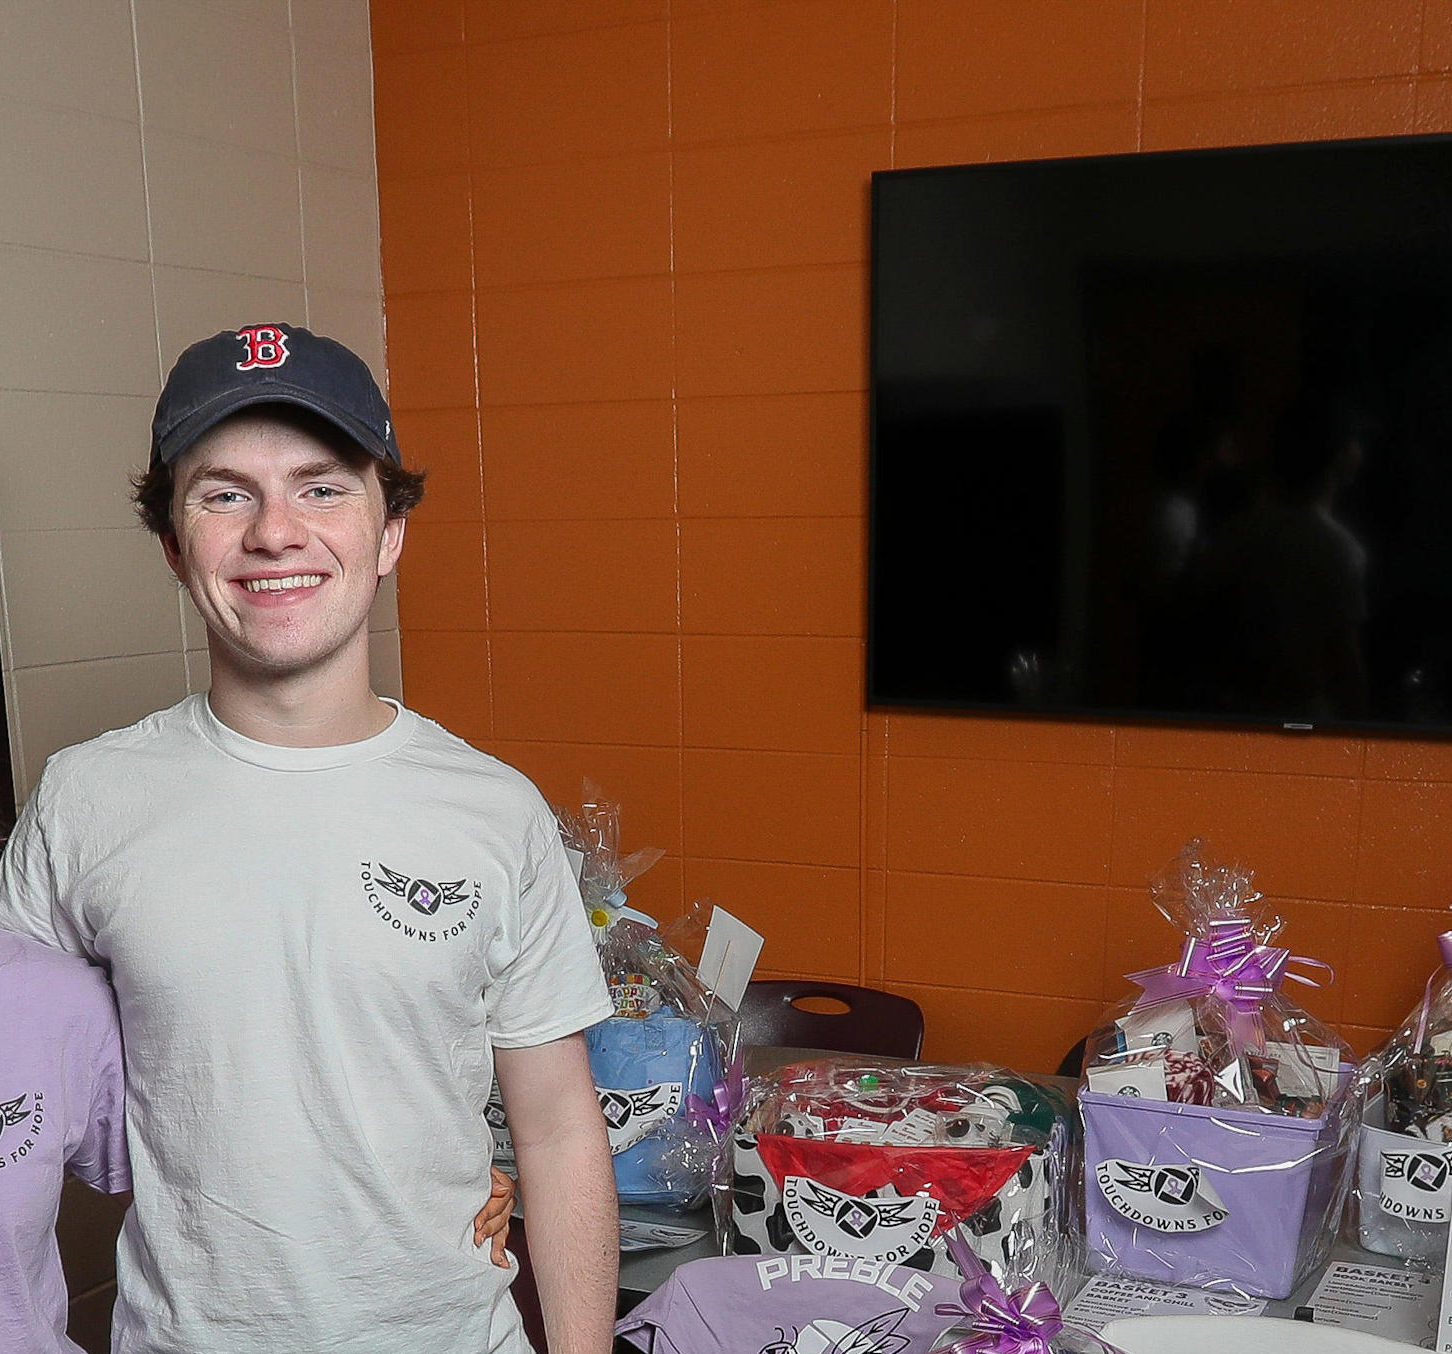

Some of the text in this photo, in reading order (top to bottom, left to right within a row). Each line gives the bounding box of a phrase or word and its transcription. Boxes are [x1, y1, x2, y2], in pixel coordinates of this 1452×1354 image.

[236, 325, 290, 370] B
[361, 861, 481, 941] TOUCHDOWNS FOR HOPE
[10, 1138, 34, 1163] FOR
[31, 1092, 43, 1135] HOPE
[912, 1201, 937, 1244] HOPE
[1097, 1163, 1197, 1230] TOUCHDOWNS
[757, 1255, 934, 1312] PREBLE
